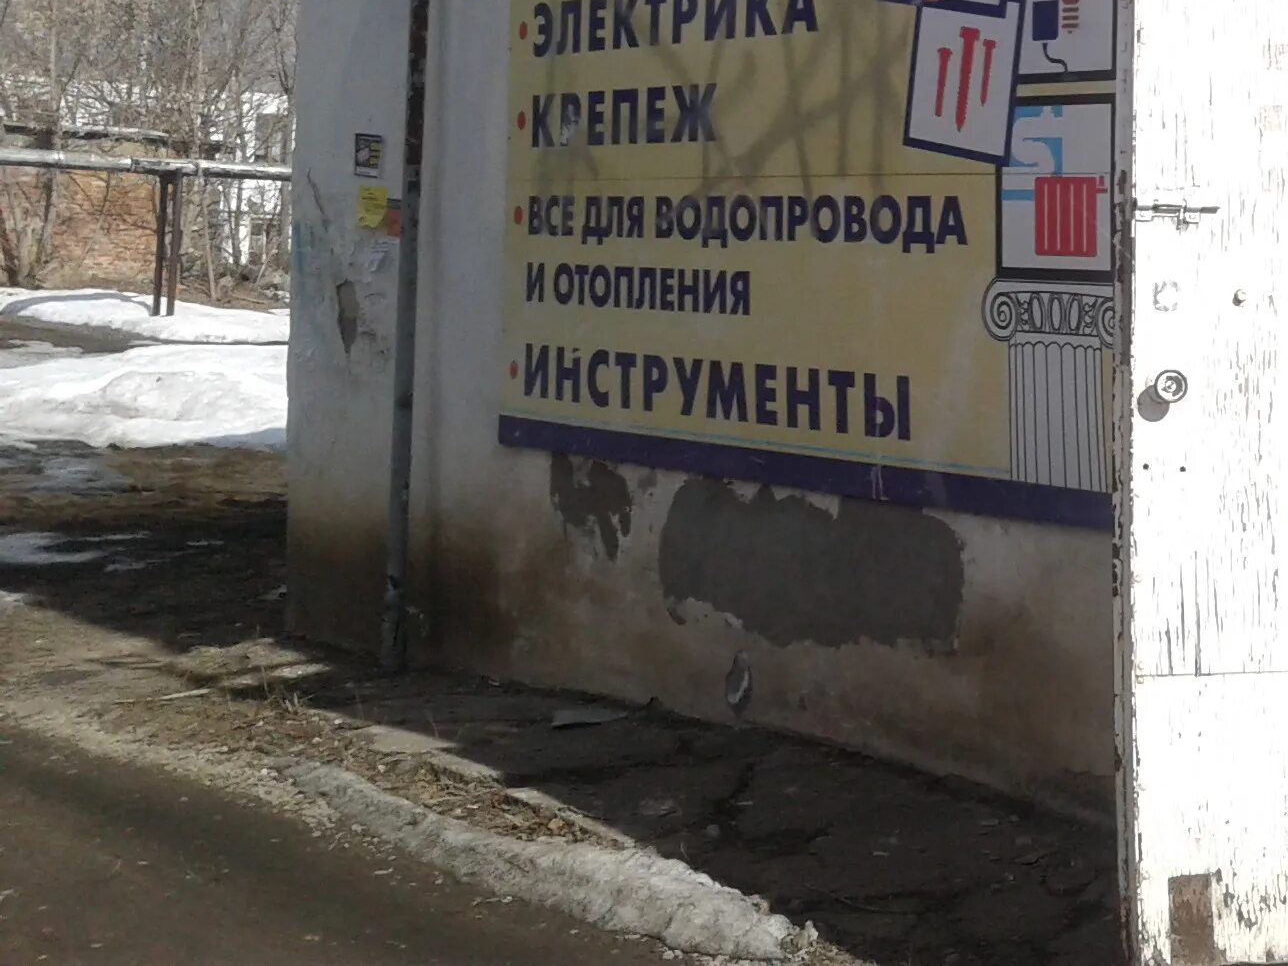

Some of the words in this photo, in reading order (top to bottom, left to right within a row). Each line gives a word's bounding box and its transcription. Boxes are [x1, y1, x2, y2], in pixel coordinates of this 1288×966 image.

[530, 82, 718, 149] КРЕПЕЖ
[528, 195, 574, 237] ВСЕ
[580, 195, 645, 246] ДЛЯ
[655, 193, 969, 254] ВОДОПРОВОДА
[525, 261, 546, 303] И
[552, 263, 752, 317] ОТОПЛЕНИЯ
[522, 341, 913, 442] ИНСТРУМЕНТЫ
